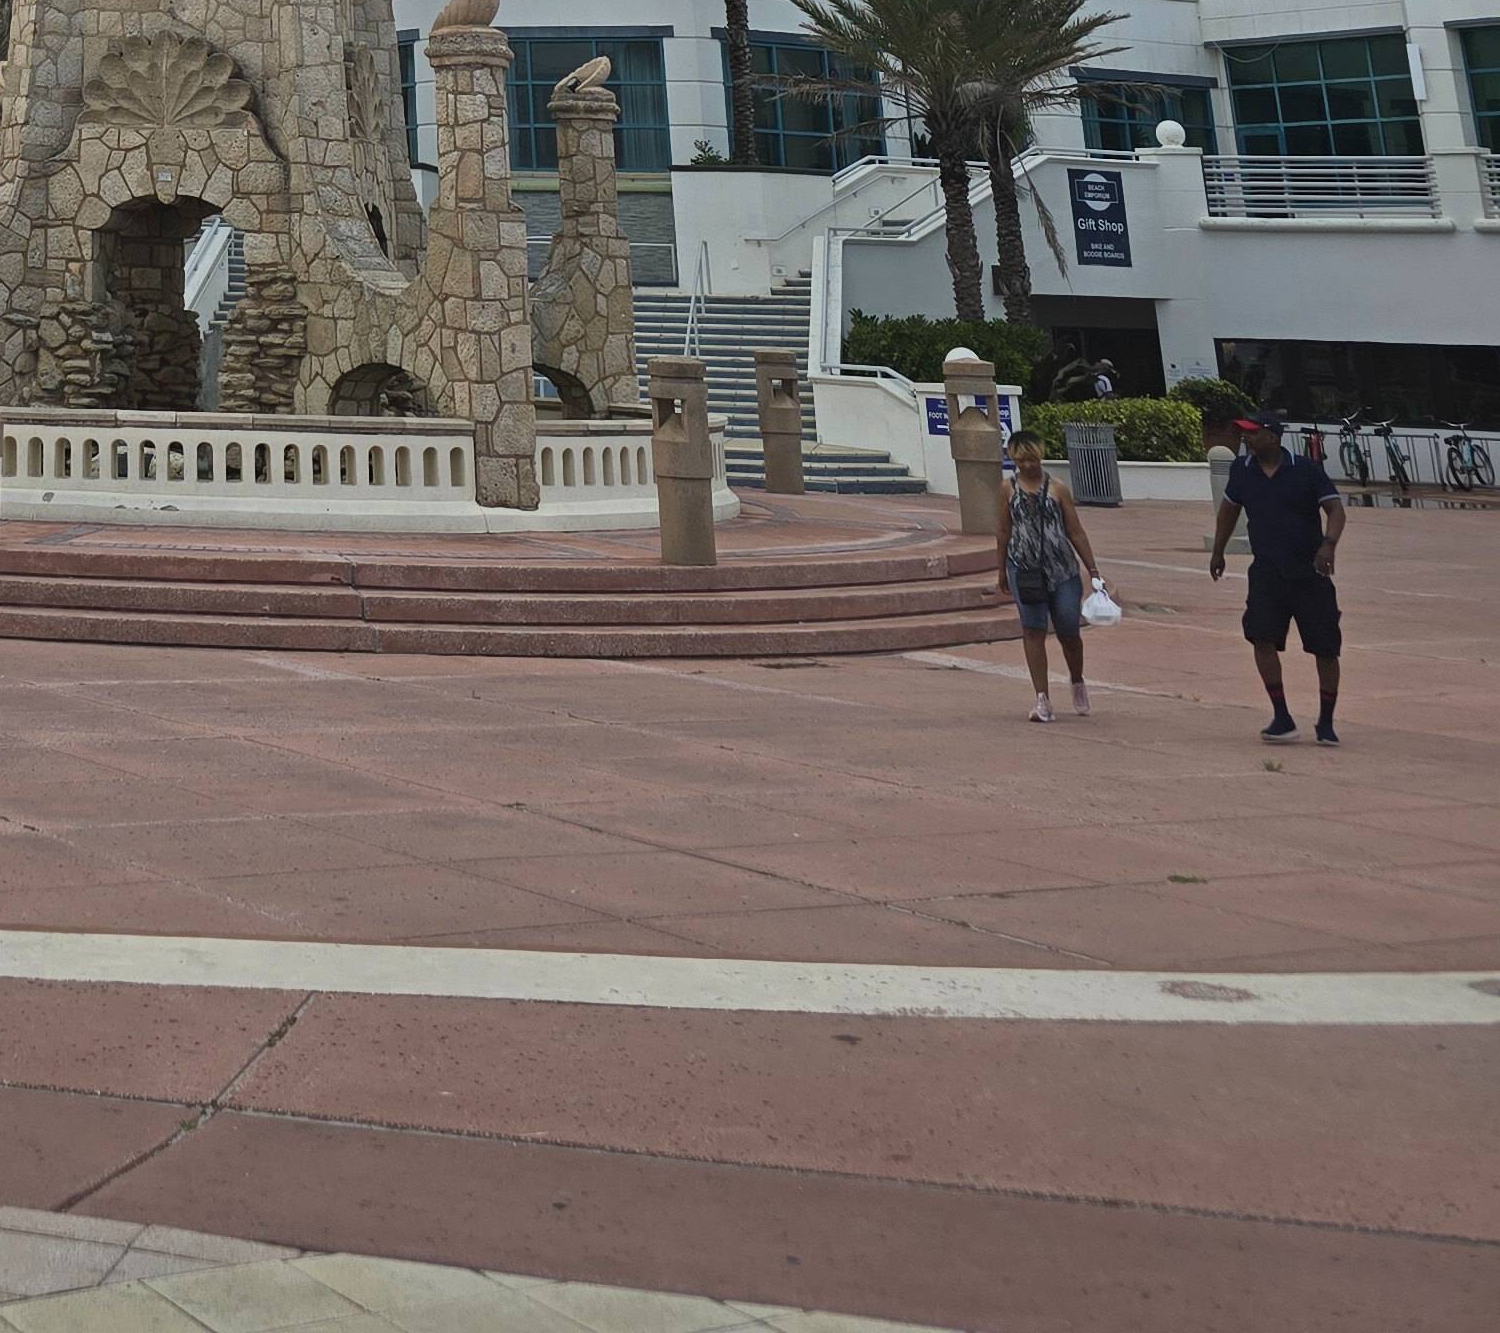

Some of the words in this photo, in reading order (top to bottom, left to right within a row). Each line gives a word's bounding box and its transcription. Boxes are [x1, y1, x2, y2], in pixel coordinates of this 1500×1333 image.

[1078, 218, 1096, 231] Gift
[1098, 219, 1124, 234] Shop
[1103, 243, 1115, 251] AND
